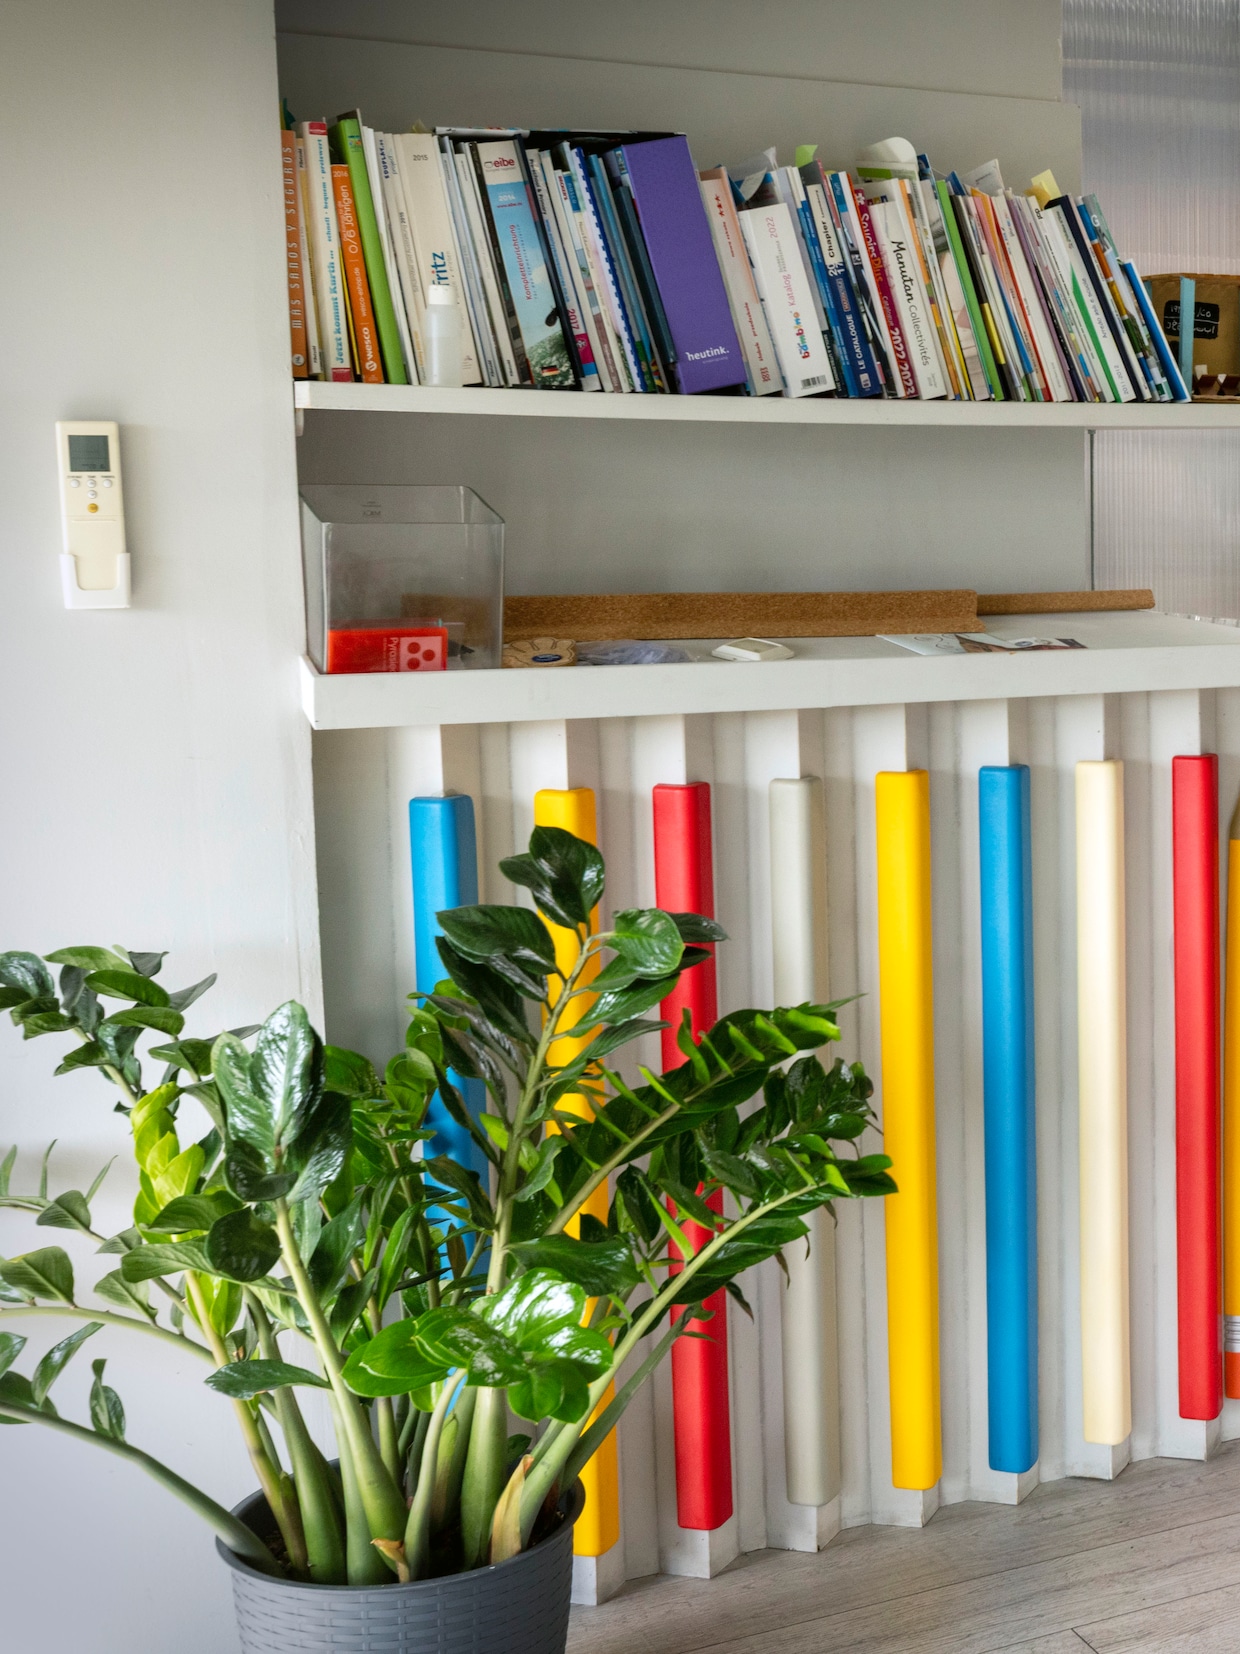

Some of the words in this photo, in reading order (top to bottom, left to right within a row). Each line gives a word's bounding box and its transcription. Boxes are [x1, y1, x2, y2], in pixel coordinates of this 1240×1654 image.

[317, 139, 326, 174] preiswert
[493, 157, 515, 168] eibe
[283, 147, 296, 214] SEGUROS
[332, 169, 349, 178] 2016
[286, 224, 297, 232] Y
[324, 216, 332, 242] schnell
[765, 216, 778, 239] 2022
[821, 221, 835, 258] Chapier
[288, 242, 300, 289] SANOS
[327, 261, 338, 294] Kurth
[508, 224, 532, 300] Kompletteinrichtung
[354, 266, 367, 317] wesco-eshop.de
[782, 273, 796, 307] Katalog
[891, 240, 914, 304] Manutan
[909, 304, 930, 366] Collectivités
[291, 299, 302, 329] MAS
[332, 296, 342, 335] kommt
[567, 308, 580, 330] 2017
[335, 337, 344, 364] Jetzt
[362, 327, 374, 360] wesco
[793, 311, 811, 359] bambino
[845, 314, 863, 357] CATALOGUE
[685, 346, 730, 362] heutink.
[858, 358, 866, 370] LE
